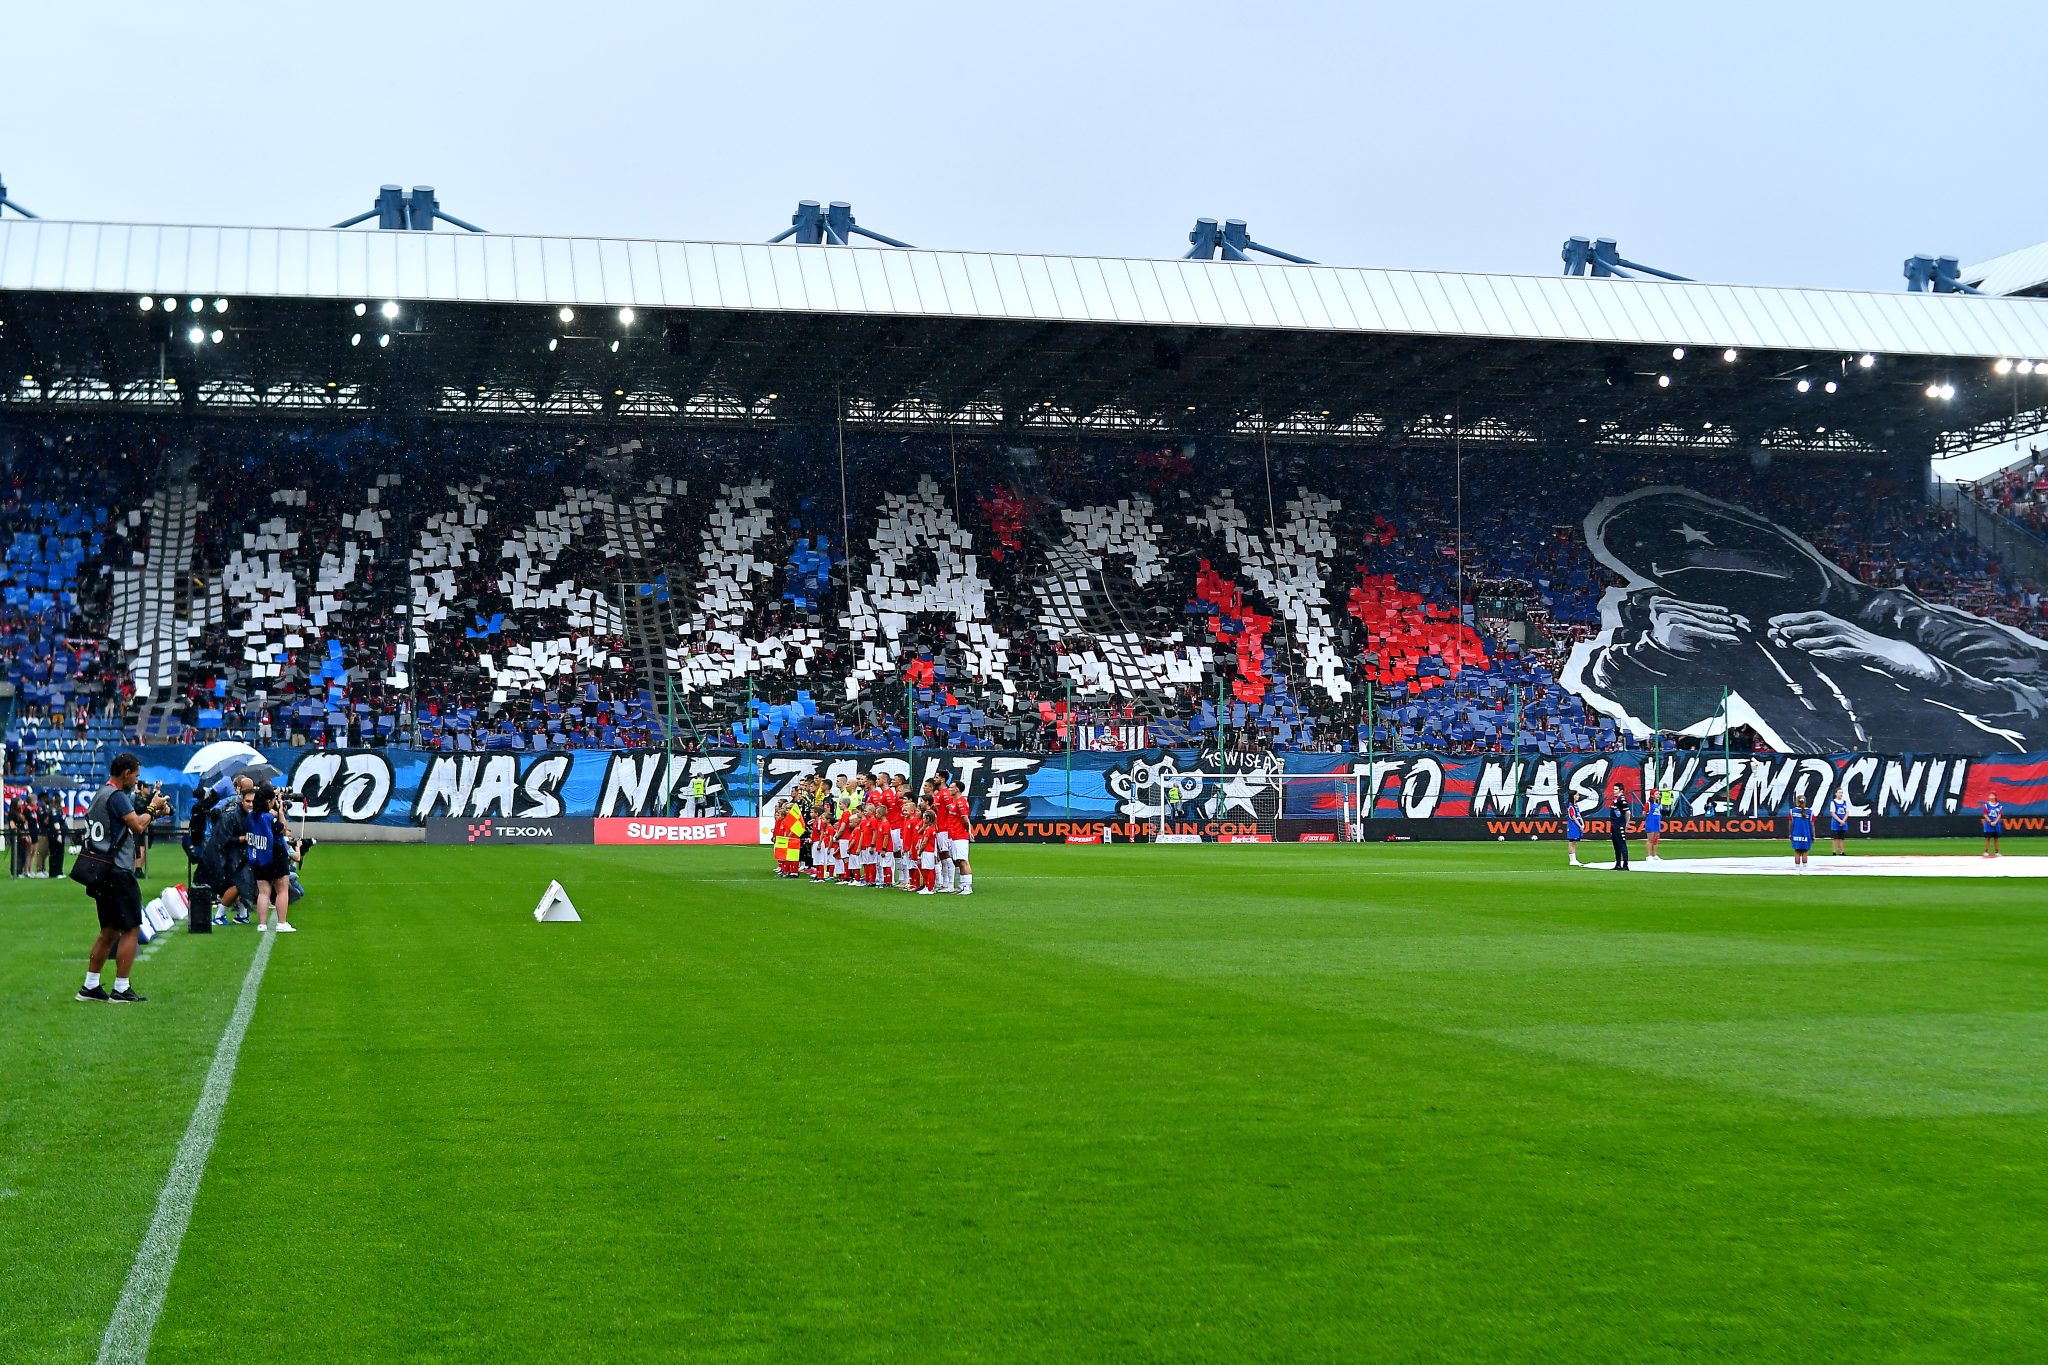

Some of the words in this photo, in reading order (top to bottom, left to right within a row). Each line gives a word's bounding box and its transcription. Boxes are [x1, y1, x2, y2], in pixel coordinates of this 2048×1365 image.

[287, 751, 391, 820] CO
[416, 755, 569, 820] NAS
[598, 753, 737, 818] NIE
[1353, 757, 1443, 819] TO
[1473, 758, 1609, 819] NAS
[1643, 756, 1967, 818] WZMOCNI!
[495, 826, 553, 838] TEXOM
[627, 822, 729, 841] SUPERBET
[1231, 835, 1260, 843] Betclic
